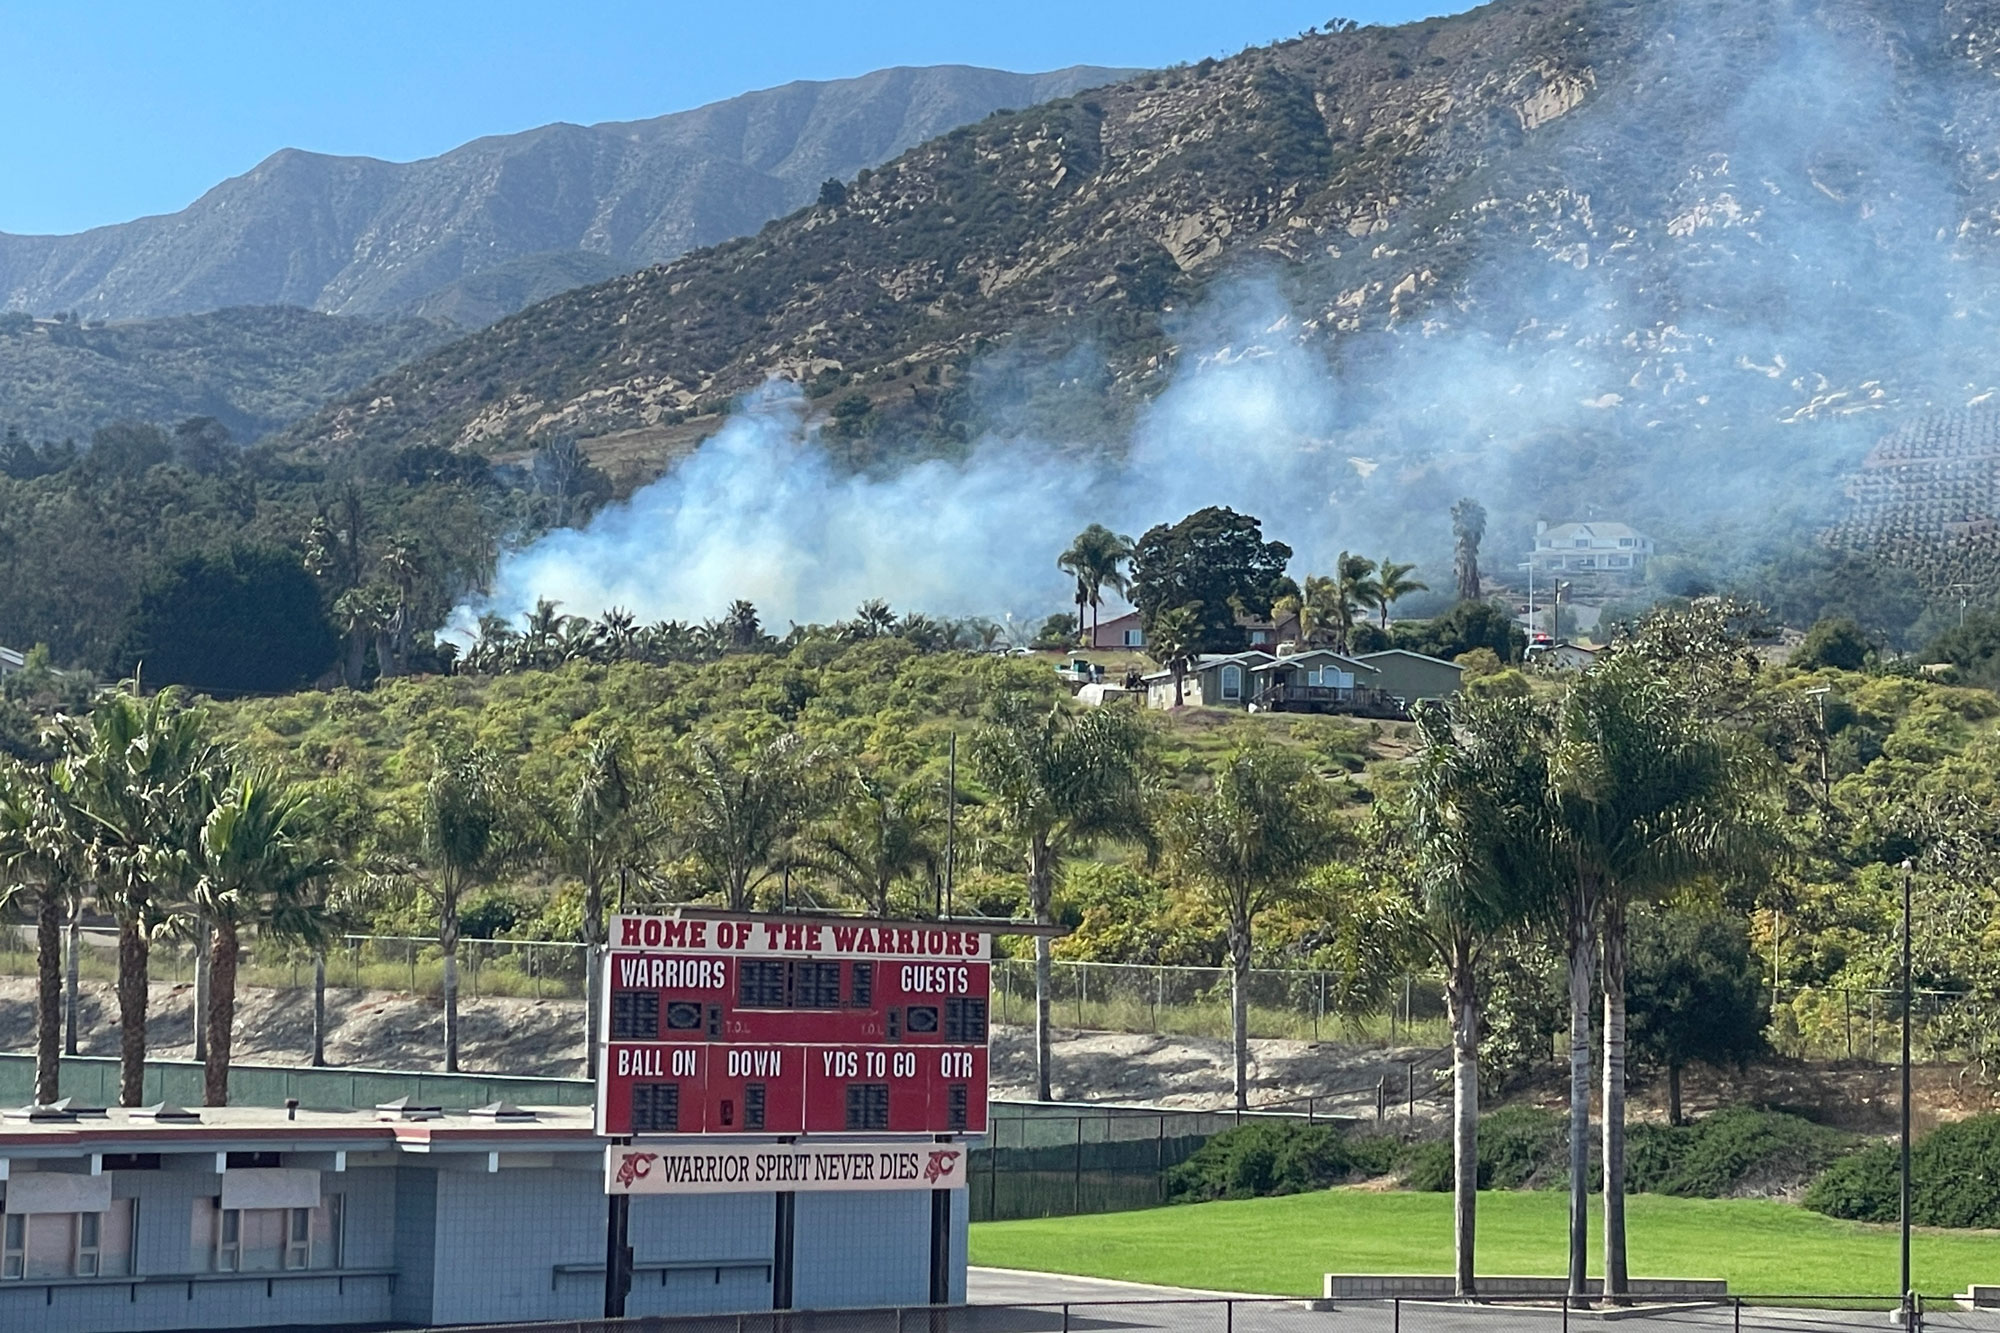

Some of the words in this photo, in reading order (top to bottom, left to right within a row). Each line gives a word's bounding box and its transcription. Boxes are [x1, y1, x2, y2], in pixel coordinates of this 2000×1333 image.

[621, 919, 706, 948] HOME
[717, 922, 753, 950] OF
[764, 925, 822, 951] THE
[832, 926, 980, 955] WARRIORS
[621, 959, 725, 988] WARRIORS
[901, 966, 968, 993] GUESTS
[618, 1050, 664, 1077] BALL
[672, 1050, 696, 1076] ON
[728, 1051, 781, 1077] DOWN
[823, 1051, 858, 1077] YDS
[866, 1052, 886, 1077] TO
[893, 1052, 916, 1078] GO
[941, 1053, 973, 1078] QTR
[663, 1155, 749, 1183] WARRIOR
[755, 1154, 811, 1181] SPIRIT
[815, 1153, 873, 1180] NEVER
[880, 1153, 919, 1180] DIES
